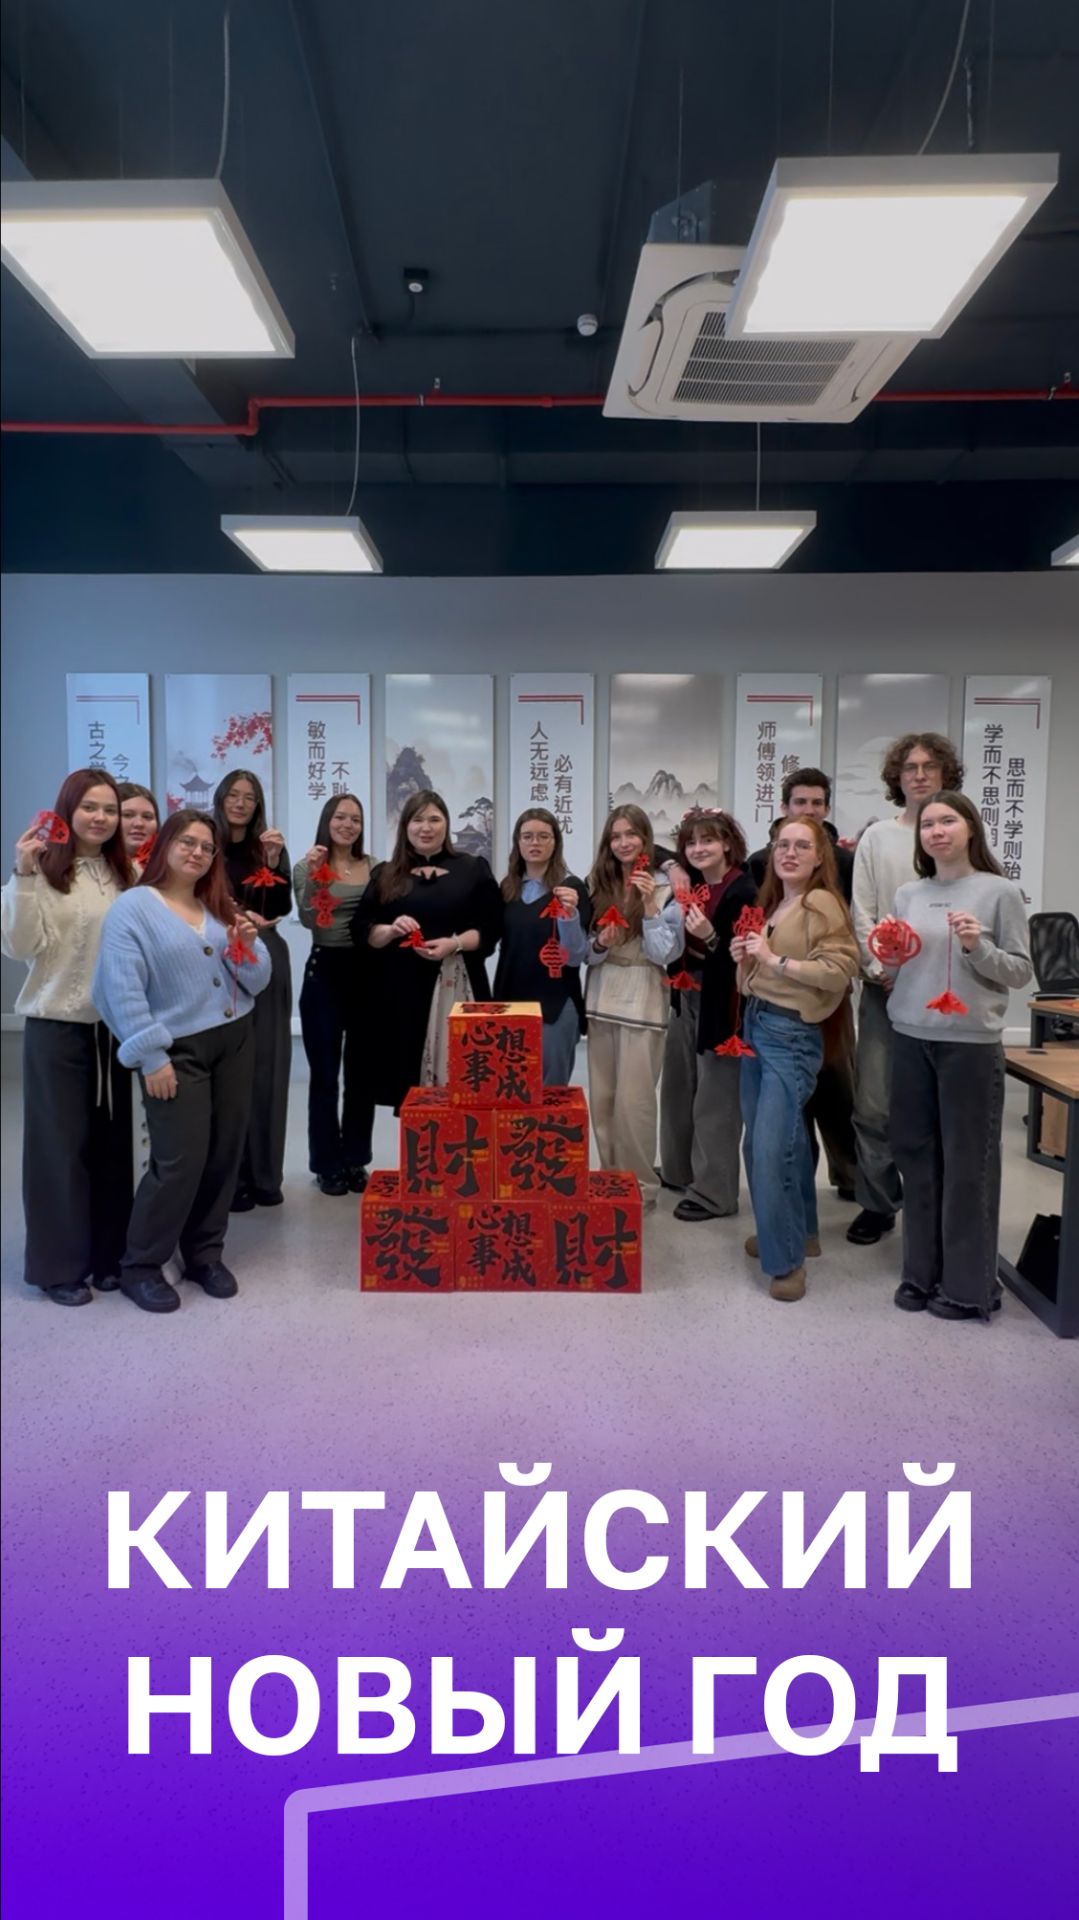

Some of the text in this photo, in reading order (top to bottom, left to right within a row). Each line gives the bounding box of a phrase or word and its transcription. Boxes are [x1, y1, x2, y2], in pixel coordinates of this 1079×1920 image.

[307, 720, 327, 801] 敏而好学
[530, 720, 549, 802] 人无远虑
[755, 721, 777, 823] 师傅领进门
